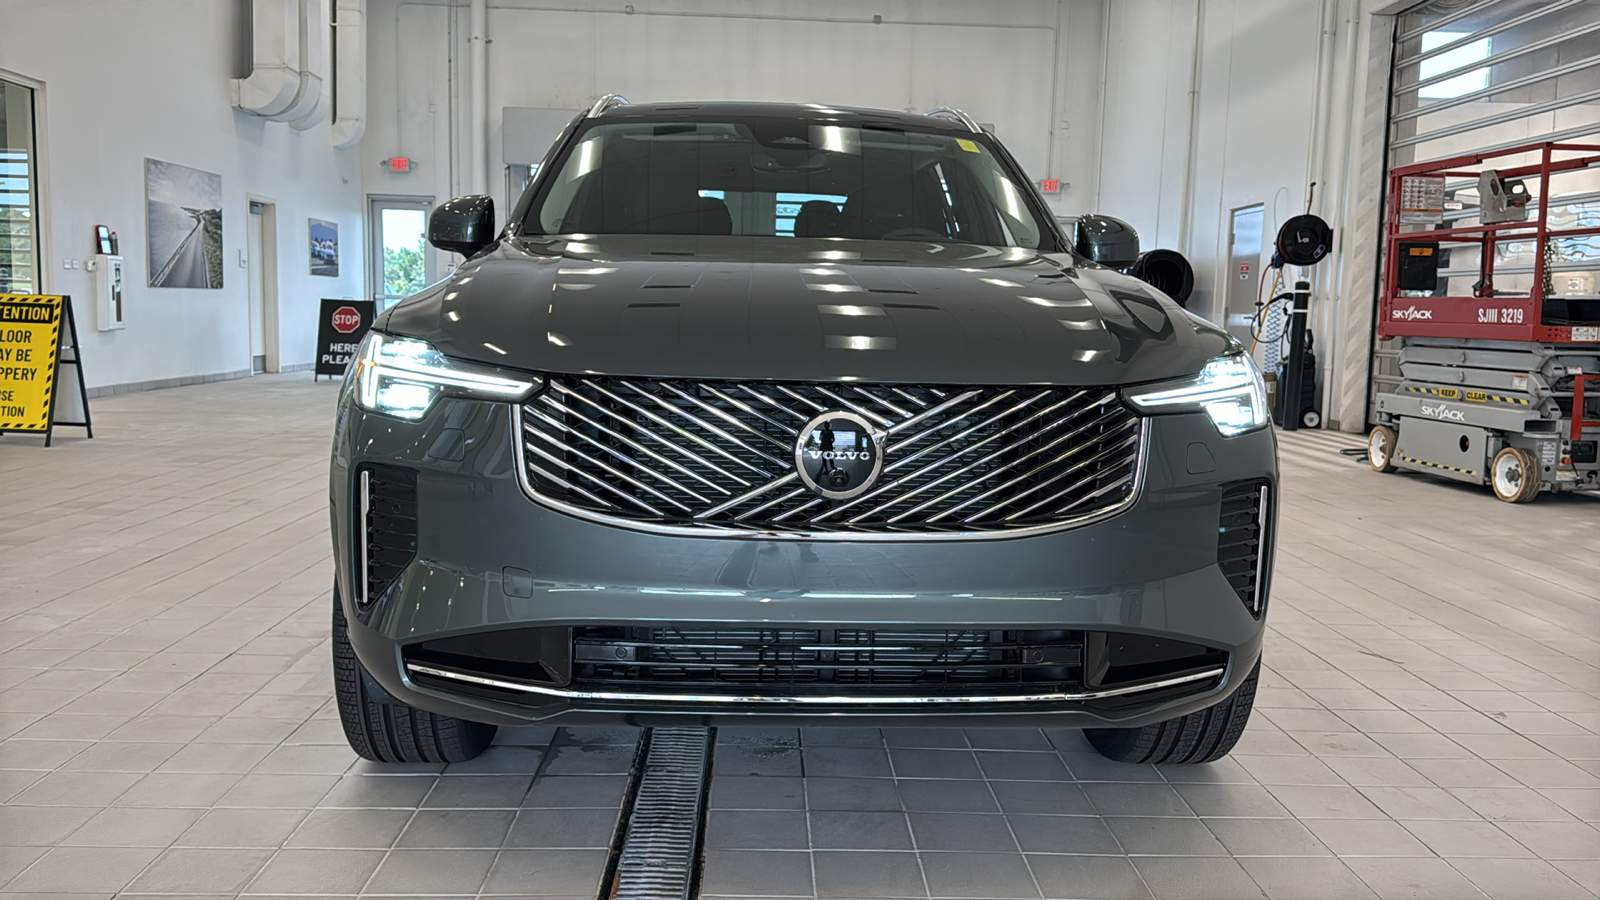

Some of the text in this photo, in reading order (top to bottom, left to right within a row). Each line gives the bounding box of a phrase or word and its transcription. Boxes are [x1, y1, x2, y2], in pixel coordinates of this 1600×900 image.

[1043, 179, 1058, 192] EXIT
[334, 314, 358, 325] STOP
[1392, 305, 1433, 321] SKYJACK
[1478, 308, 1524, 324] SJIII 3219
[16, 348, 32, 362] BE
[322, 355, 350, 364] PLEA
[1440, 389, 1487, 401] KEEP CLEAR
[1421, 403, 1466, 421] SKYJACK
[808, 450, 871, 460] VOLVO
